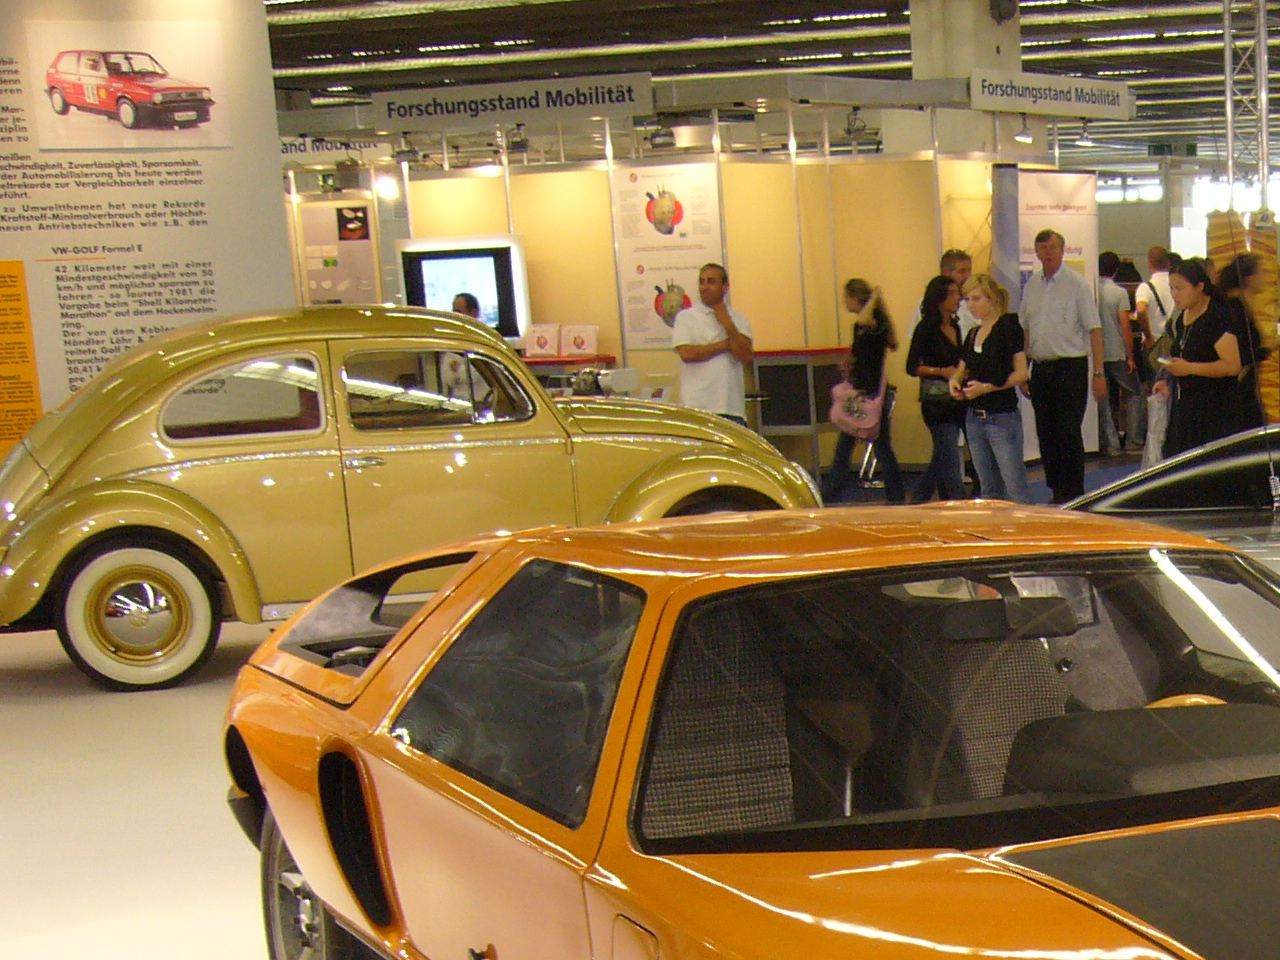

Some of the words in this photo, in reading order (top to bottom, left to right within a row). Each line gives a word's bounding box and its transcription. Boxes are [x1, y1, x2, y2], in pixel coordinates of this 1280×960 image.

[981, 79, 1072, 103] Forschungsstand
[1074, 87, 1121, 107] Mobilität
[387, 89, 540, 120] Forschungsstand
[546, 84, 635, 108] Mobilität
[1, 172, 17, 180] der
[22, 170, 114, 180] Automobilisierung
[117, 170, 131, 178] bis
[134, 169, 162, 177] heute
[166, 168, 203, 176] werden
[75, 179, 155, 189] Vergleichbarkeit
[22, 203, 102, 213] Umweltthemen
[108, 202, 126, 210] hat
[163, 200, 206, 208] Rekorde
[0, 210, 141, 222] Kraftstoff-Minimalverbrauch
[145, 210, 167, 218] oder
[38, 221, 135, 231] Antriebstechniken
[140, 219, 158, 227] wie
[188, 218, 208, 226] den
[52, 245, 100, 255] VW-GOLF
[102, 244, 135, 253] Formel
[137, 244, 144, 252] E
[55, 265, 68, 273] 42
[74, 264, 127, 273] Kilometer
[133, 262, 156, 270] weit
[162, 261, 179, 269] mit
[185, 260, 213, 268] einer
[56, 270, 176, 282] Mindestgeschwindigkeit
[57, 283, 84, 291] km/h
[109, 281, 156, 291] möglichst
[159, 279, 200, 289] sparsam
[58, 292, 93, 301] fahren
[127, 289, 163, 298] lautete
[169, 287, 194, 296] 1981
[200, 286, 216, 295] die
[59, 301, 102, 312] Vorgabe
[105, 300, 129, 308] beim
[115, 309, 131, 317] auf
[133, 308, 153, 316] dem
[62, 321, 85, 330] ring.
[101, 345, 120, 354] Golf
[68, 365, 93, 375] 50,41
